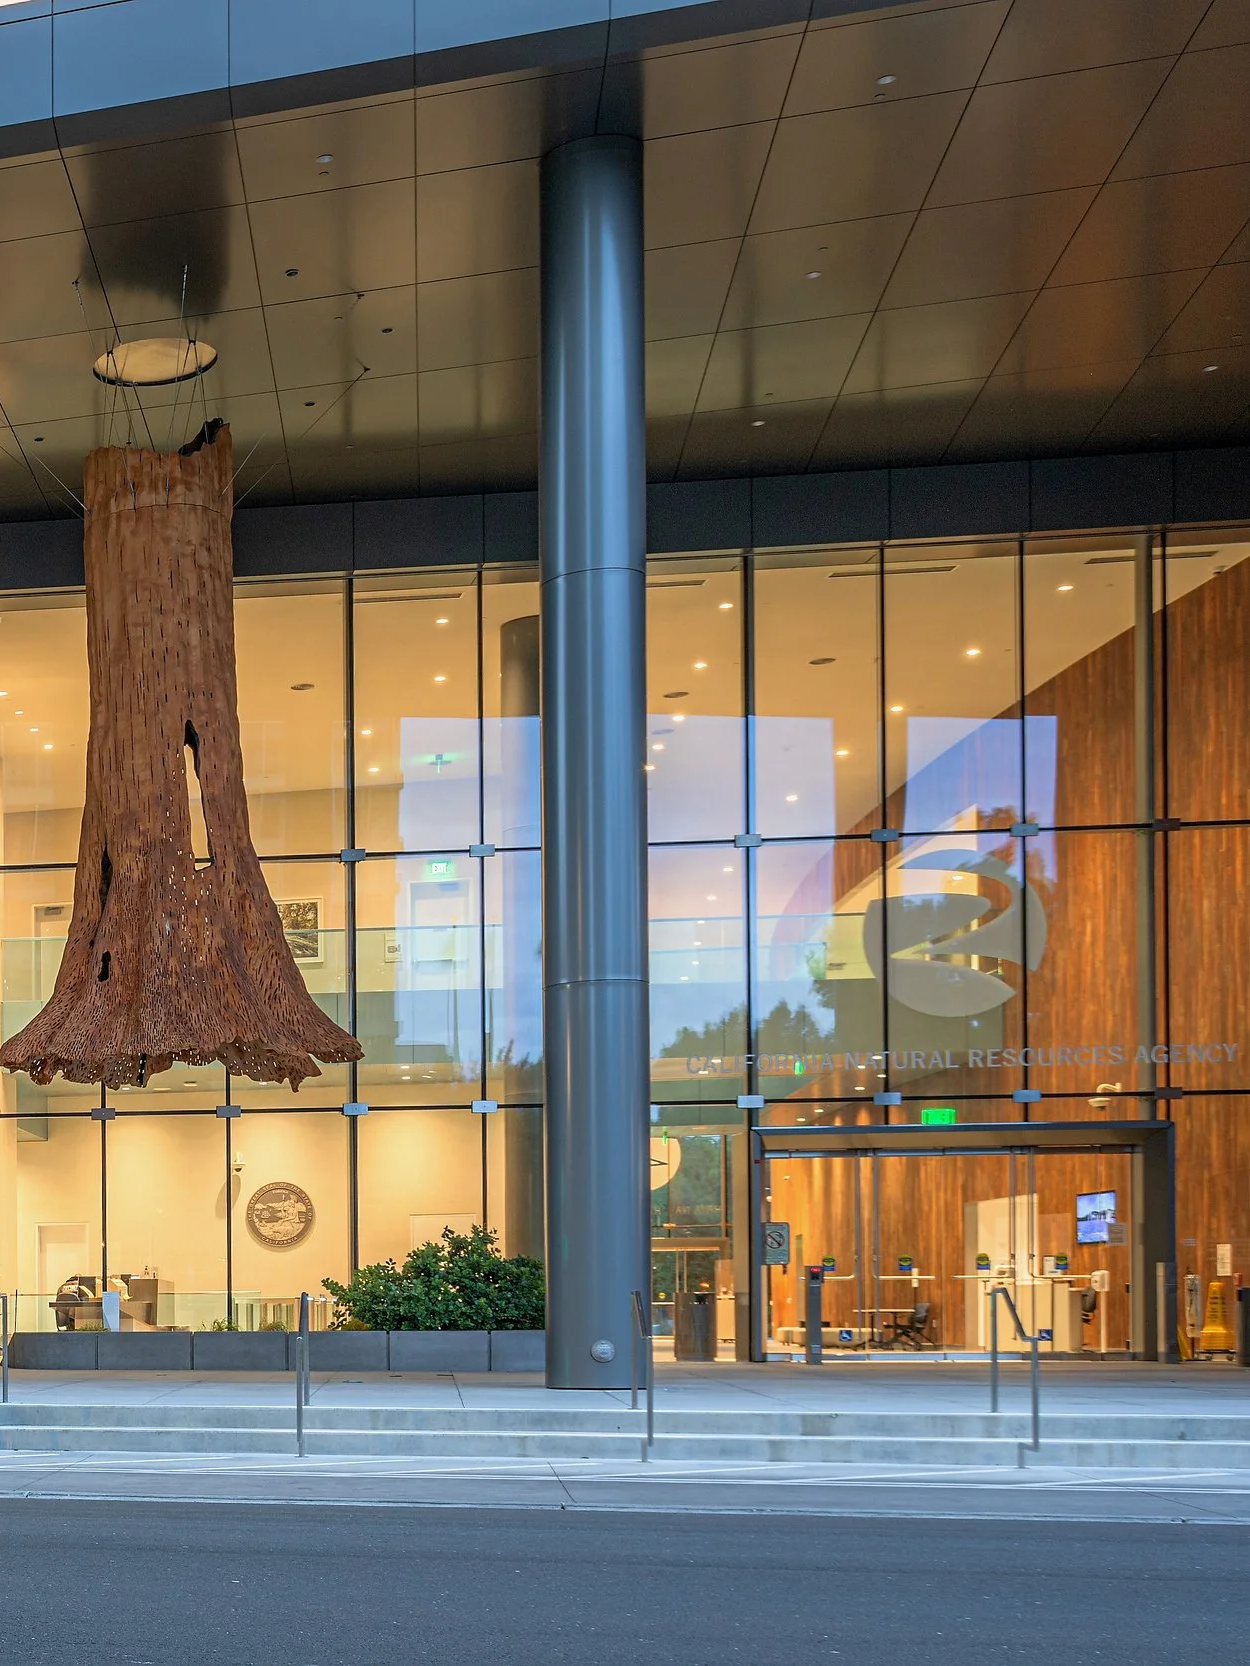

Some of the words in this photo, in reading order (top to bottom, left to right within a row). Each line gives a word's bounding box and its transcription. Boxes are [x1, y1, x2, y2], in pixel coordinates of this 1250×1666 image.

[687, 1053, 834, 1074] CALIFORNIA
[845, 1051, 959, 1070] NATURAL
[968, 1045, 1125, 1068] RESOURCES
[1135, 1043, 1238, 1063] AGENCY
[261, 1236, 298, 1245] CALIFORNIA
